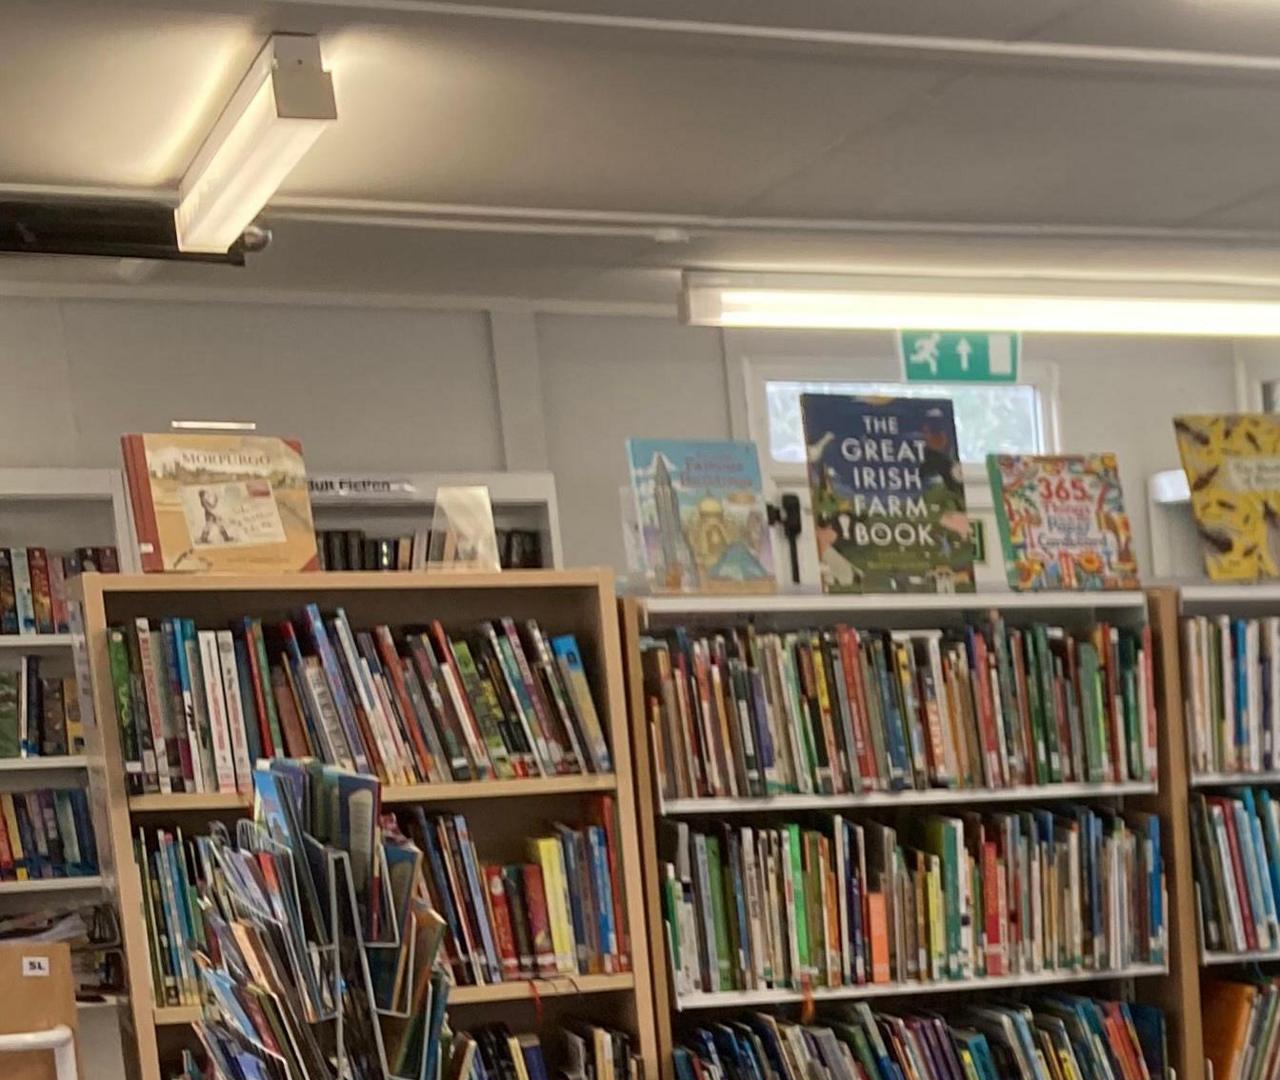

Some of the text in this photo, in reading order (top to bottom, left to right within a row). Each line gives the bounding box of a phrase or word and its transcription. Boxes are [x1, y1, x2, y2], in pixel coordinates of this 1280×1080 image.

[861, 415, 899, 435] THE
[181, 453, 272, 466] MORPURGO
[840, 437, 927, 463] GREAT
[852, 466, 922, 491] IRISH
[1037, 476, 1089, 502] 365
[852, 494, 941, 518] FARM-
[854, 522, 936, 547] BOOK
